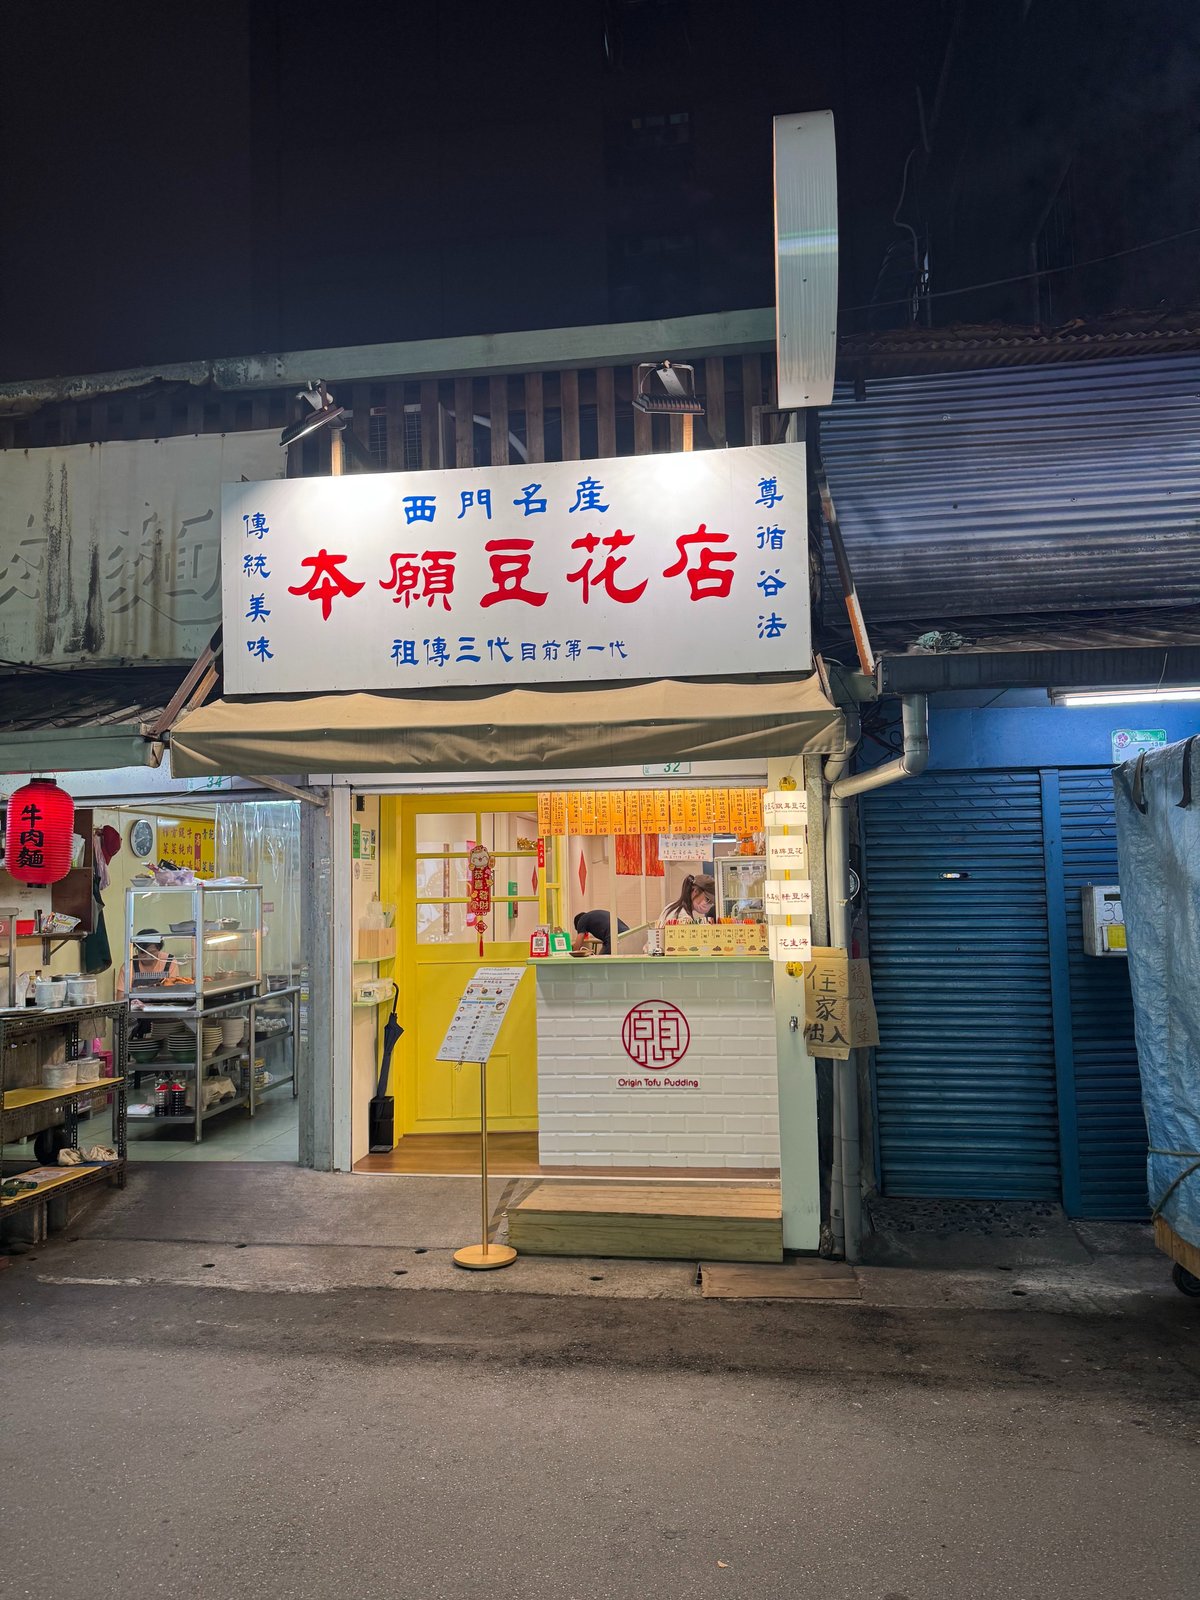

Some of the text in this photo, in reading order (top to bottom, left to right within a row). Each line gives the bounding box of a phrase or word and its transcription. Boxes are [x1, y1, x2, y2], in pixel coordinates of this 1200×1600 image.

[243, 512, 274, 662] 傳統美味
[287, 524, 735, 621] 本願豆花店
[390, 636, 627, 667] 祖傳三代目前第一代
[207, 775, 222, 788] 34
[664, 761, 680, 773] 32
[16, 803, 46, 869] 牛肉麵
[474, 870, 489, 910] 恭喜發財
[618, 1078, 699, 1087] Origin Tofu Pudding
